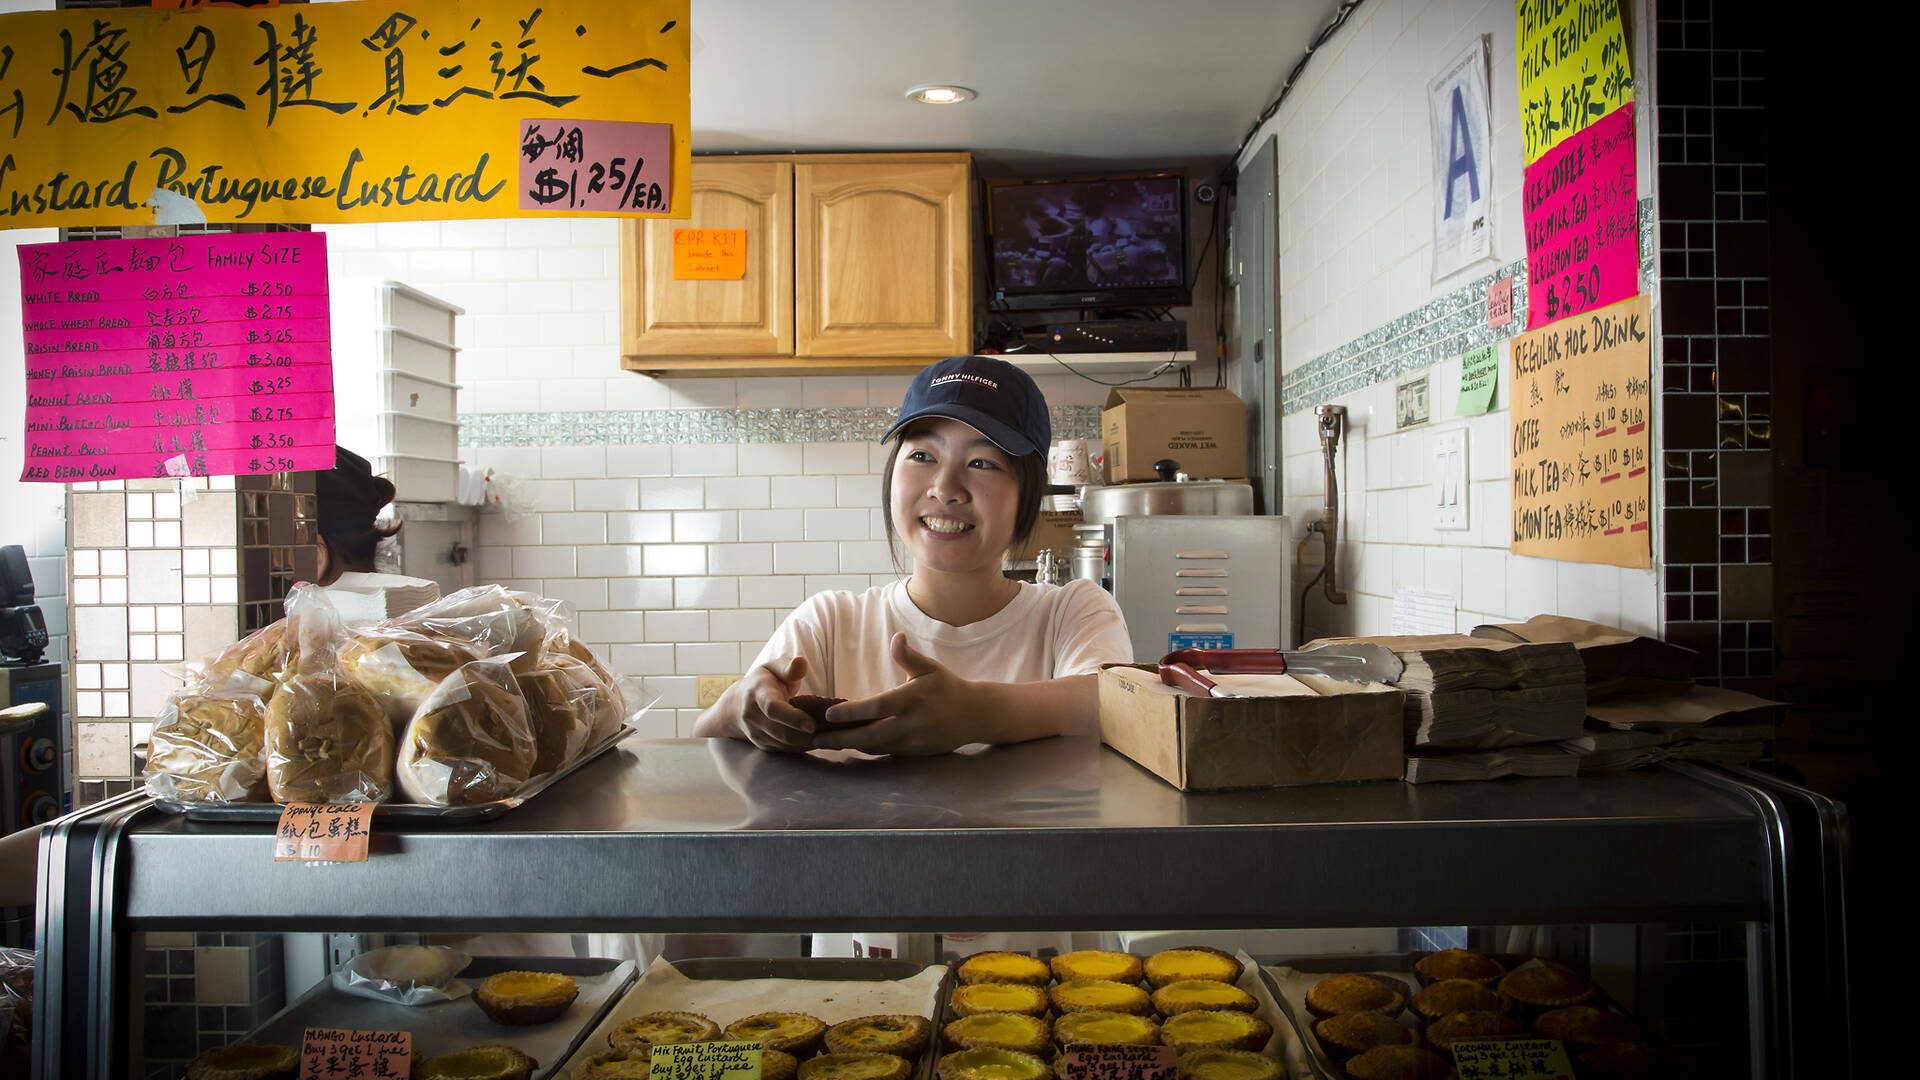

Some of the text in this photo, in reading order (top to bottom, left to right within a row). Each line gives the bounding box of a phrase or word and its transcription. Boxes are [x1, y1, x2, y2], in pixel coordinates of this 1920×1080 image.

[522, 125, 583, 163] 每個
[1444, 85, 1480, 220] A
[337, 149, 507, 211] Custard
[1545, 141, 1587, 198] COFFEE
[1571, 192, 1588, 227] TEA
[675, 230, 740, 247] CPR KIT
[1573, 234, 1588, 263] TEA
[25, 290, 61, 304] WHITE
[66, 290, 101, 303] BREAD
[240, 281, 294, 297] $2.50
[25, 318, 56, 331] WHOLE
[61, 318, 95, 331] WHEAT
[98, 316, 131, 329] BREAD
[243, 304, 293, 321] $2.75
[64, 340, 99, 353] BREAD
[246, 328, 294, 344] $3.25
[1515, 332, 1561, 379] REGULAR
[1565, 324, 1588, 360] HOT
[1592, 314, 1645, 353] DRINK
[96, 363, 133, 377] BREAD
[245, 353, 292, 368] $3.00
[931, 373, 998, 389] TOMMY HILFIGER
[76, 391, 113, 405] BREAD
[249, 435, 294, 449] $3.50
[1168, 441, 1217, 450] WET WAXED
[1514, 418, 1540, 458] COFFEE
[26, 465, 50, 479] RED
[55, 464, 86, 478] BEAN
[248, 458, 294, 472] $3.50
[1514, 462, 1538, 500] MILK
[1539, 459, 1559, 495] TEA
[1514, 504, 1541, 542] LEMON
[1543, 504, 1561, 540] TEA
[305, 1030, 406, 1044] MANGO Custard
[708, 1042, 762, 1053] Portuguese
[304, 1043, 410, 1062] Buy 3 get 1 free
[673, 1053, 749, 1066] Egg Custard
[1078, 1052, 1158, 1064] Egg Custard
[1457, 1053, 1479, 1064] Buy
[1480, 1052, 1488, 1060] 3
[1489, 1051, 1508, 1062] get
[651, 1064, 673, 1075] Buy
[676, 1064, 682, 1073] 3
[684, 1063, 706, 1078] get
[711, 1063, 715, 1072] 1
[720, 1063, 754, 1074] free
[1066, 1063, 1087, 1075] Buy
[1089, 1063, 1097, 1072] 3
[1099, 1062, 1120, 1075] get
[1121, 1061, 1126, 1070] 1
[1131, 1062, 1161, 1073] free
